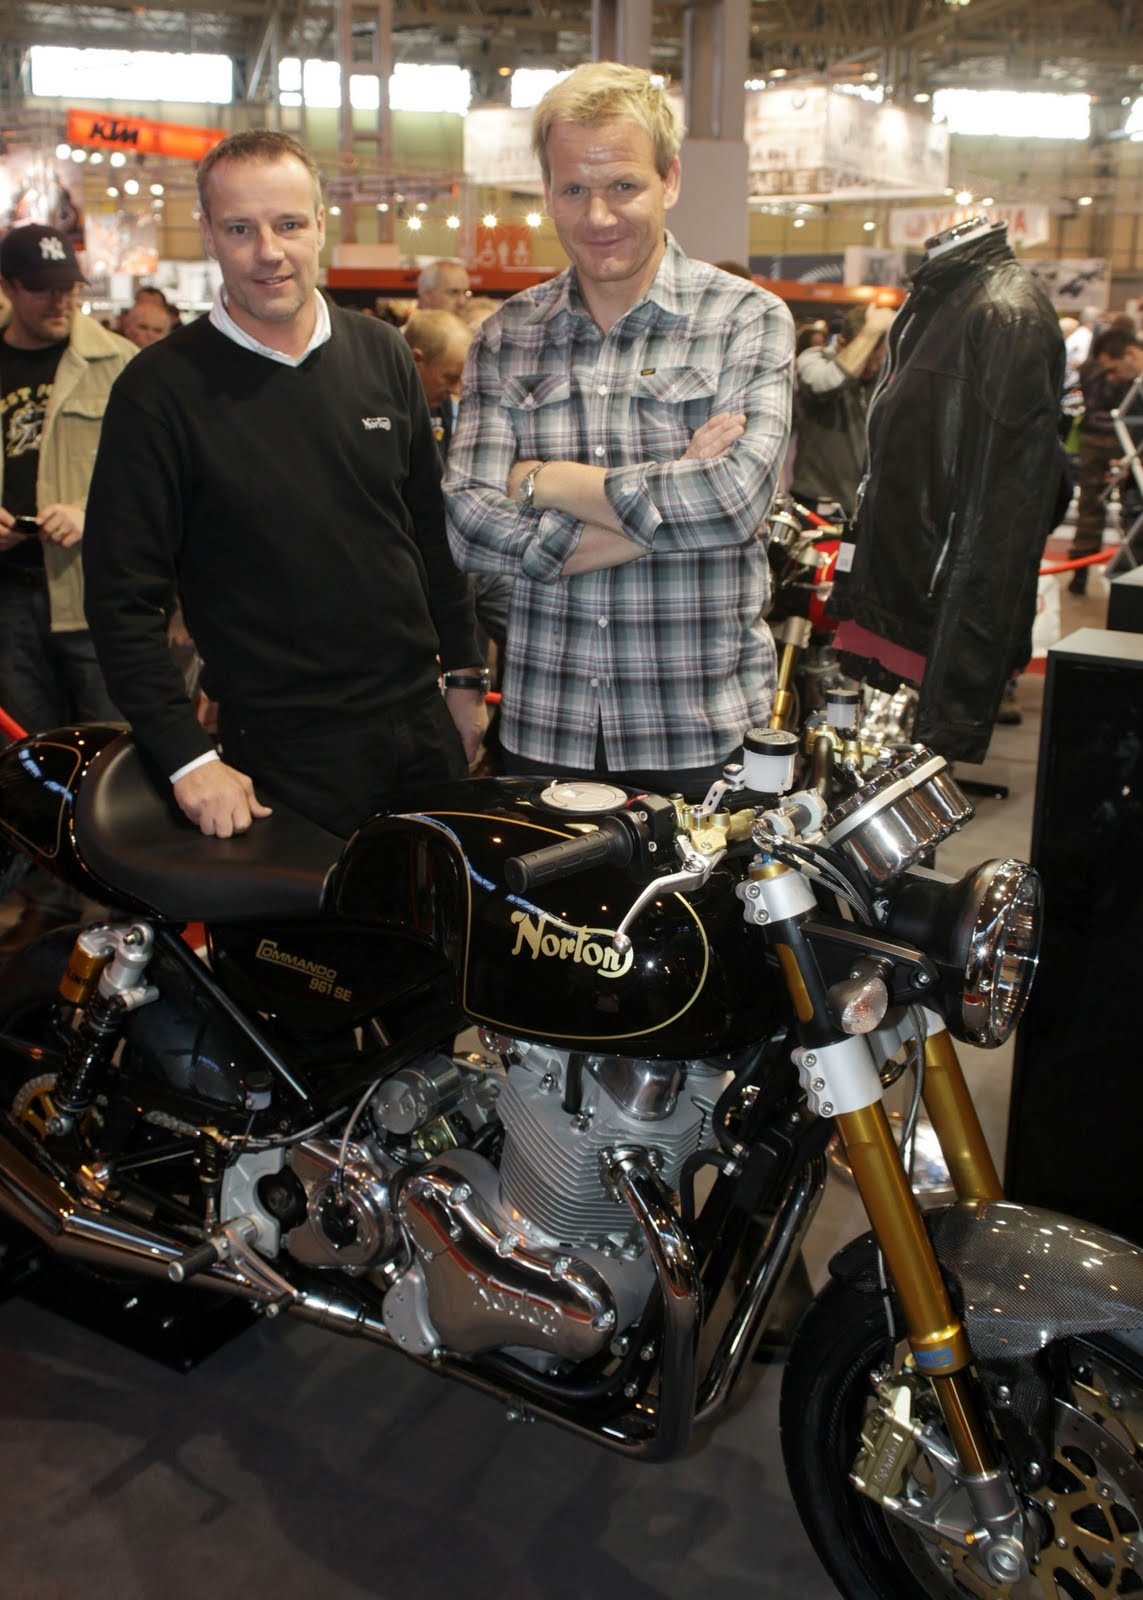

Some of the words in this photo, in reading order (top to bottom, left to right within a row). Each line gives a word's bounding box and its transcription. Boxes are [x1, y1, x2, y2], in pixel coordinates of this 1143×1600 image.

[90, 121, 138, 145] KTM
[510, 910, 634, 978] Norton
[308, 977, 334, 995] 961
[333, 985, 352, 1002] SE
